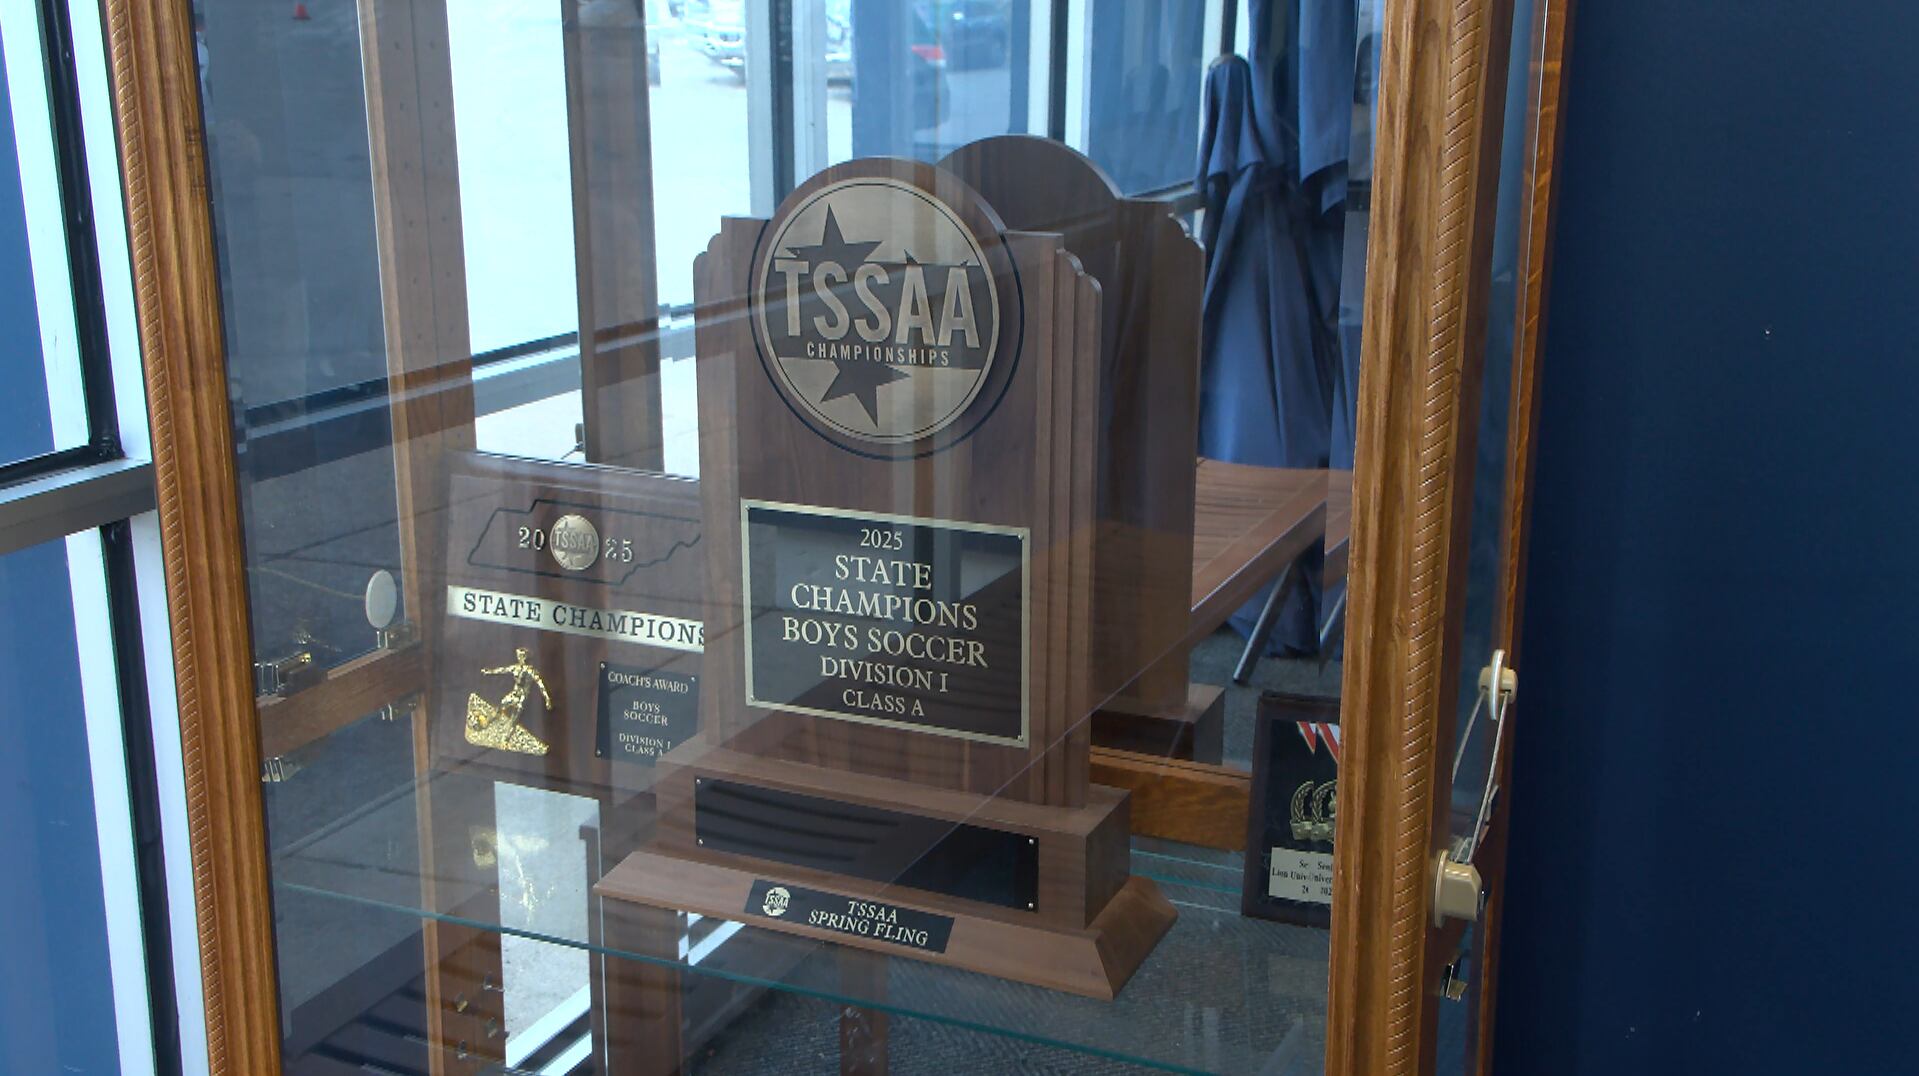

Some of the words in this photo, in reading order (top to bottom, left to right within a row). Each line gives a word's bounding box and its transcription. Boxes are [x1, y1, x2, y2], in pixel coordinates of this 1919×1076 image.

[774, 258, 981, 349] TSSAA
[807, 341, 949, 367] CHAMPIONSHIPS
[518, 527, 545, 551] 20
[860, 528, 904, 551] 2025
[834, 554, 932, 590] STATE
[463, 592, 541, 622] STATE
[790, 582, 978, 631] CHAMPIONS
[782, 616, 859, 651] BOYS
[867, 627, 989, 669] SOCCER
[607, 671, 651, 688] COACH'S
[652, 678, 689, 694] AWARD
[820, 655, 933, 690] DIVISION
[939, 672, 949, 693] I
[632, 700, 661, 714] BOYS
[842, 688, 905, 715] CLASS
[911, 699, 925, 717] A
[623, 709, 668, 727] SOCCER
[619, 732, 664, 748] DIVISION
[624, 743, 655, 757] CLASS
[848, 900, 898, 924] TSSAA
[808, 909, 870, 935] SPRING
[873, 923, 929, 946] FLING
